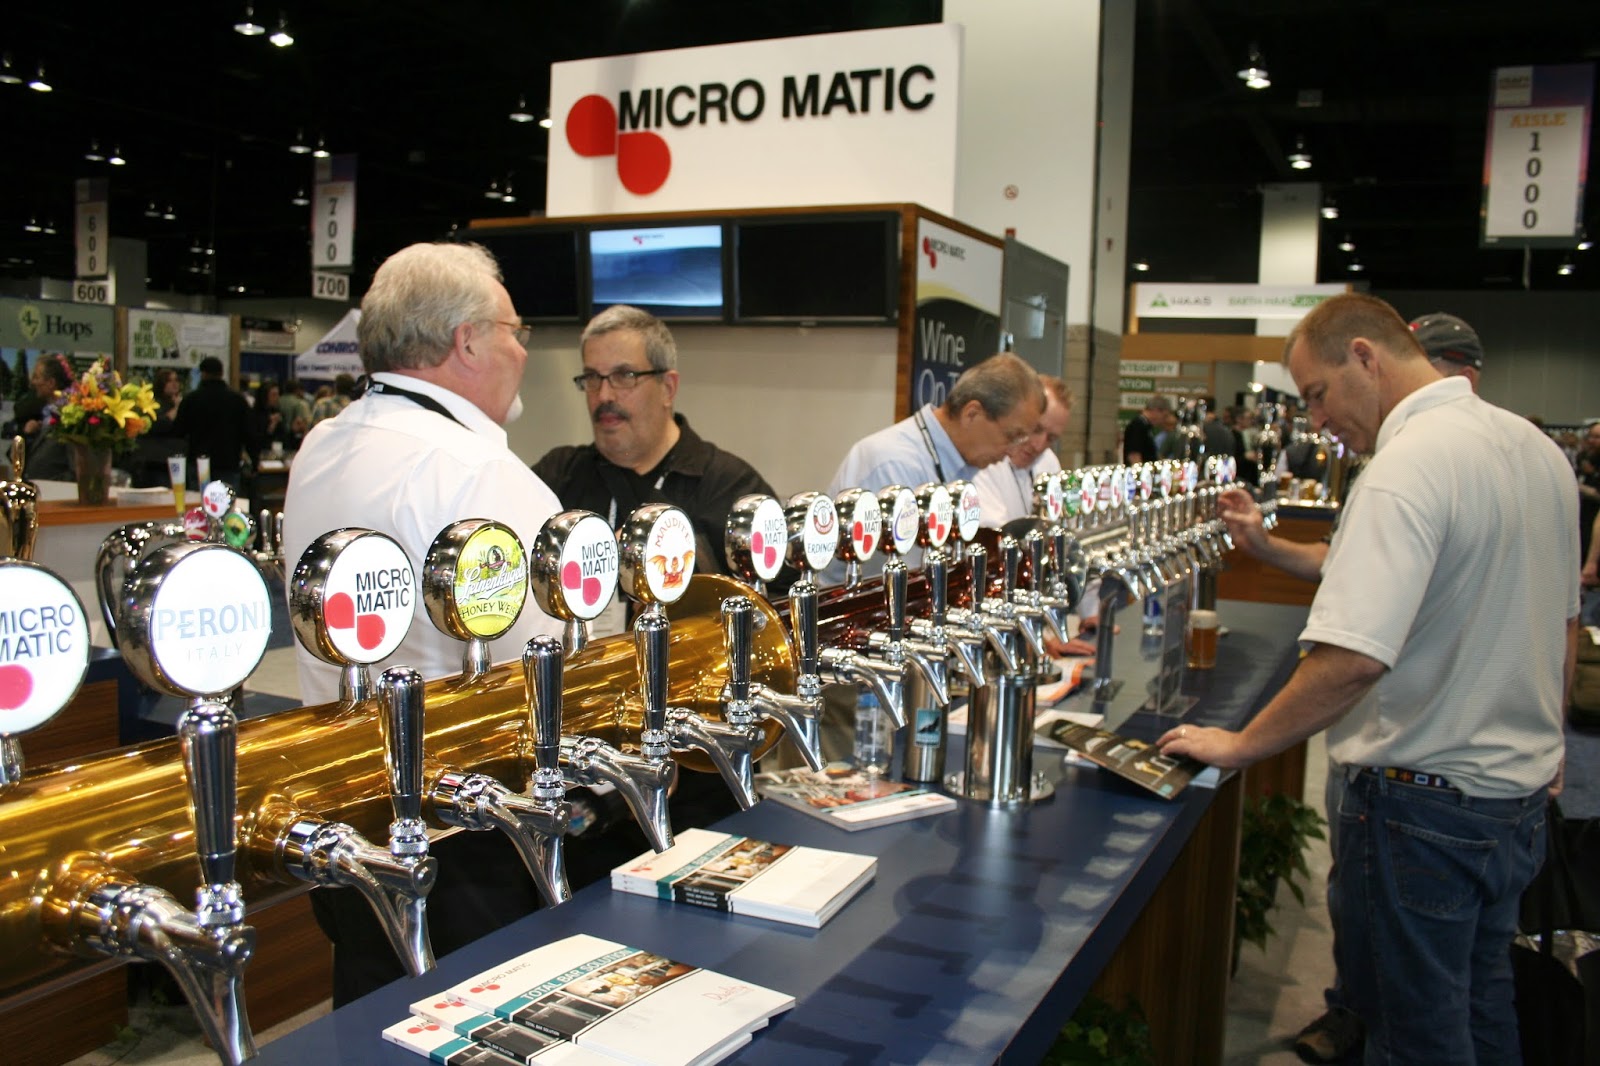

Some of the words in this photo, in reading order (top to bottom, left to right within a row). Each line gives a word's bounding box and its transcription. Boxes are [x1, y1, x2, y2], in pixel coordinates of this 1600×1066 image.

[617, 79, 765, 131] MICRO
[781, 65, 936, 118] MATIC
[1510, 112, 1567, 128] AISLE
[1522, 131, 1542, 230] 1000
[327, 197, 339, 262] 700
[77, 284, 106, 302] 600
[317, 275, 346, 297] 700
[46, 314, 93, 342] Hops
[920, 317, 965, 367] Wine
[919, 368, 946, 408] On
[582, 540, 617, 561] MICRO
[356, 567, 411, 592] MICRO
[582, 556, 617, 577] MATIC
[357, 587, 410, 613] MATIC
[461, 602, 496, 619] HONEY
[156, 601, 267, 641] PERONI
[187, 643, 243, 662] ITALY
[478, 972, 506, 988] MICRO
[506, 962, 531, 978] MATIC
[520, 980, 562, 1000] TOTAL
[559, 969, 582, 984] BAR
[580, 949, 634, 973] SOLUTION
